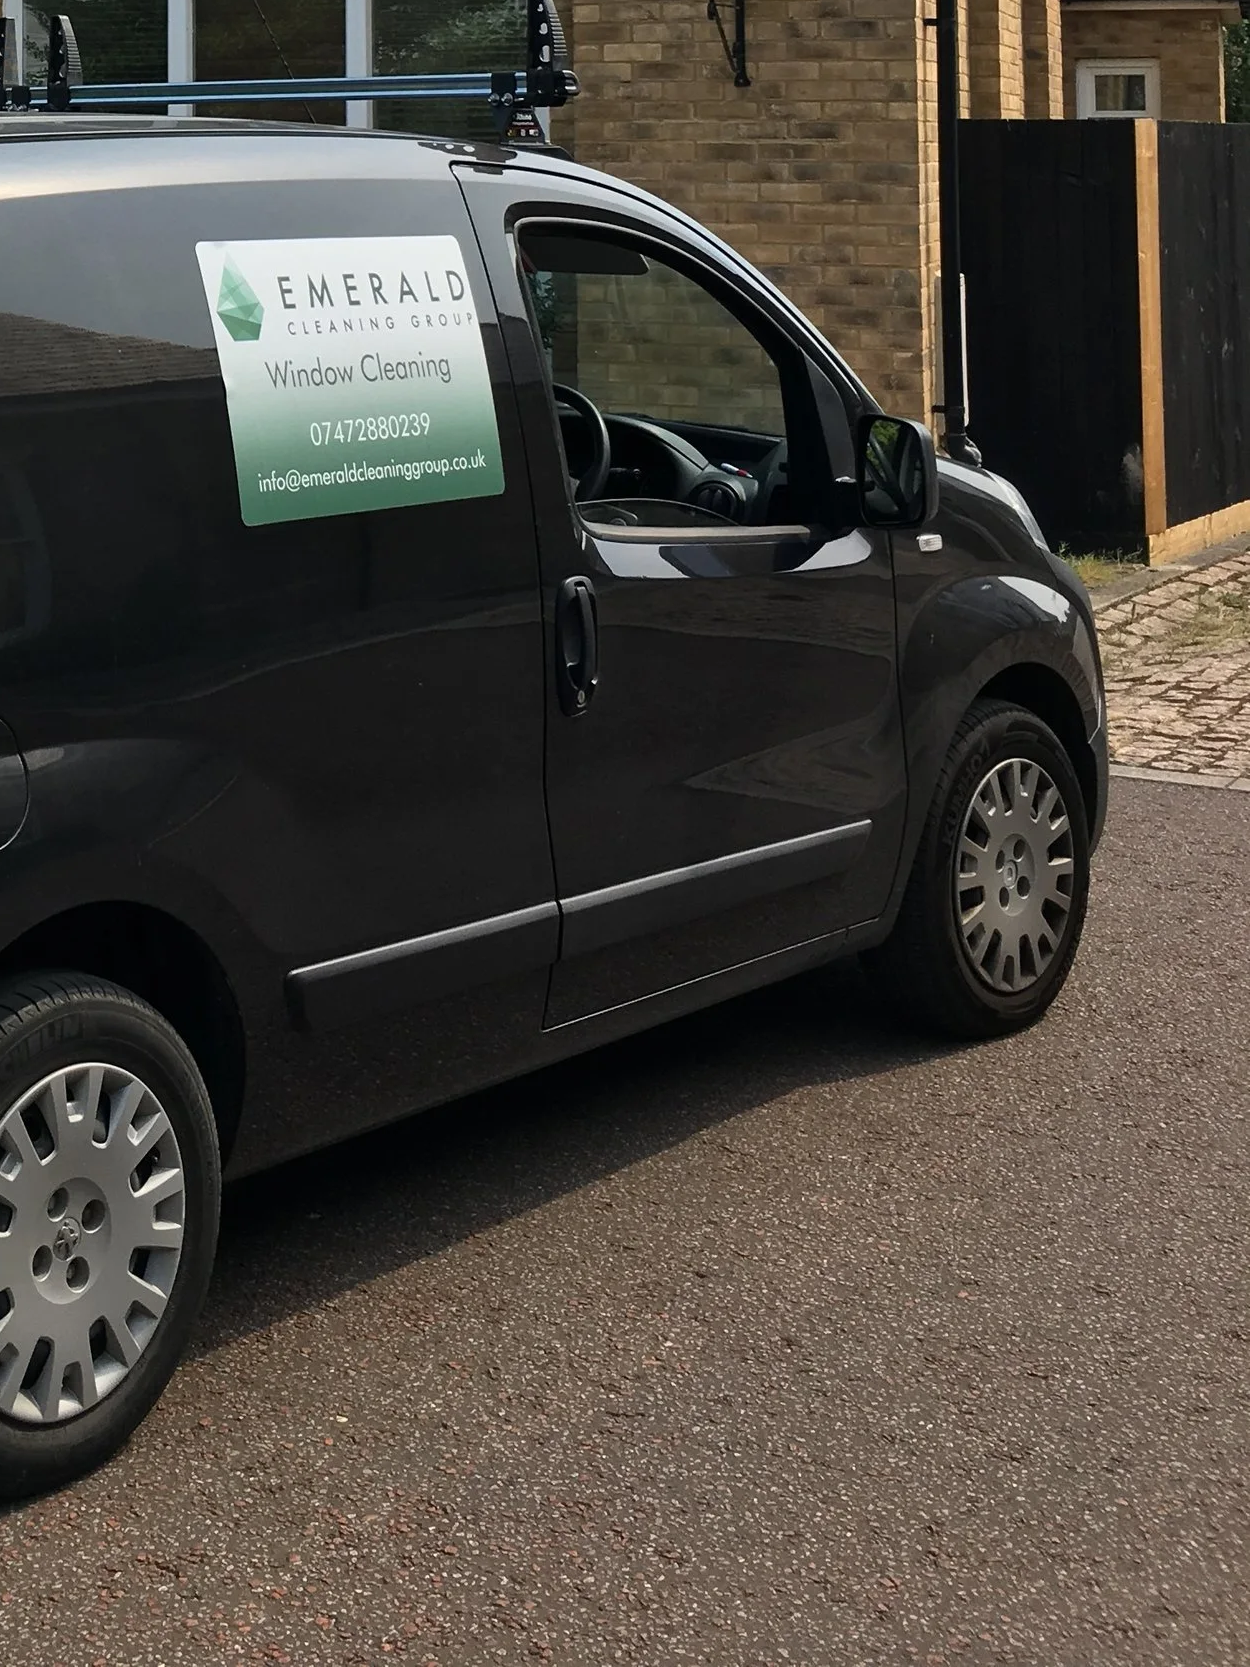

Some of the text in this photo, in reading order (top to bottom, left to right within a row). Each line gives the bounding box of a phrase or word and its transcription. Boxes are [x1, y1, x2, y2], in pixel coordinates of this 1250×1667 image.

[277, 270, 465, 309] EMERALD
[287, 312, 474, 335] CLEANING GROUP
[264, 351, 452, 390] Window Cleaning
[310, 412, 431, 446] 07472880239
[258, 448, 487, 493] info@emeraldcleaninggroup.co.uk
